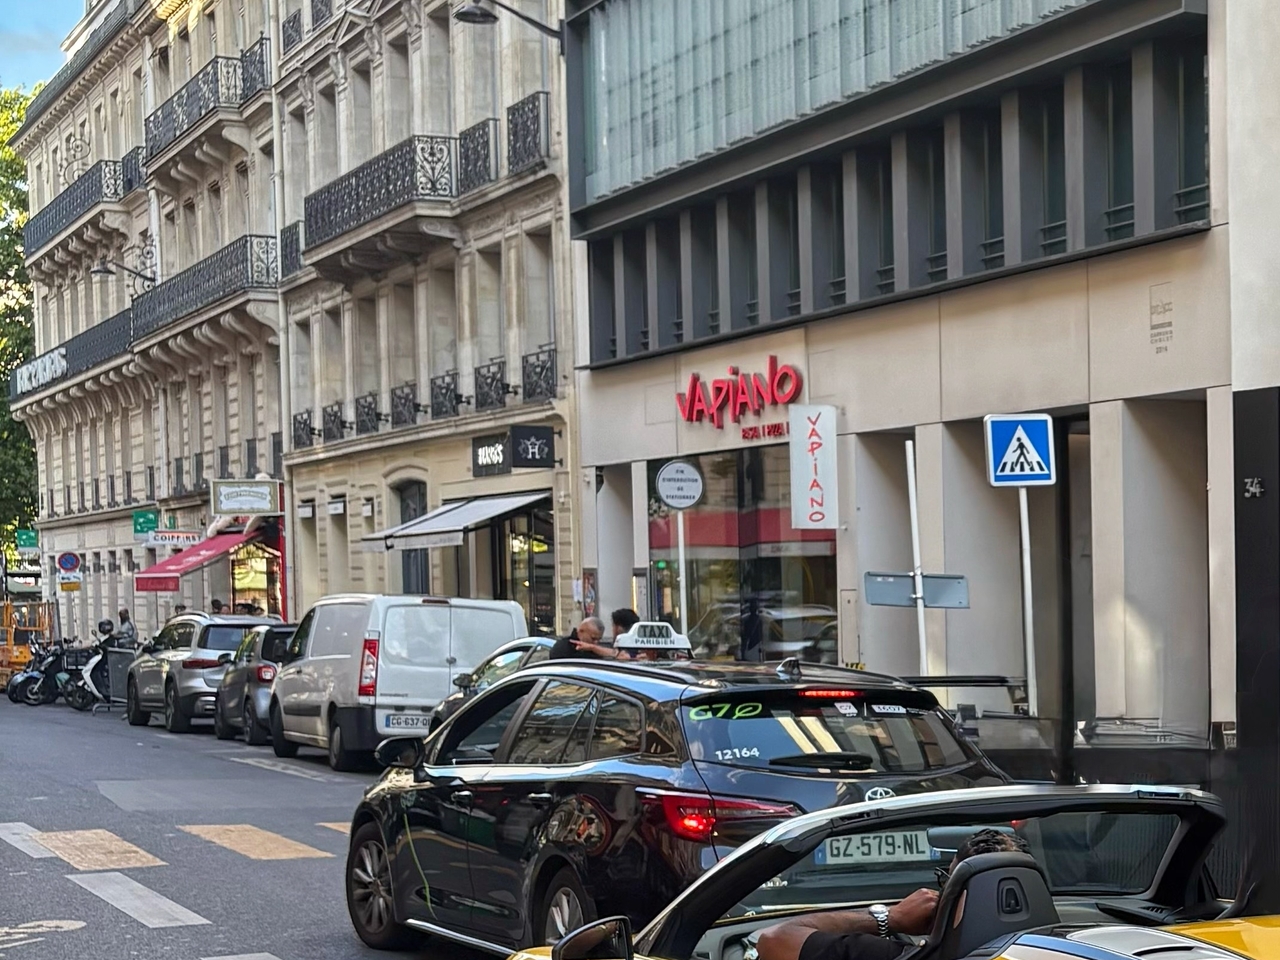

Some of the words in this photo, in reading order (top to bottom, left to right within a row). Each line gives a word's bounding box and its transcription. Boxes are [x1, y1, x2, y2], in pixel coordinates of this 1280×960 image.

[676, 355, 803, 429] VAPIANO
[807, 412, 825, 522] VAPIANO
[1244, 477, 1265, 498] 34
[641, 625, 669, 638] TAXI
[635, 638, 676, 646] PARISIEN
[689, 703, 731, 720] G7
[715, 747, 760, 760] 12164
